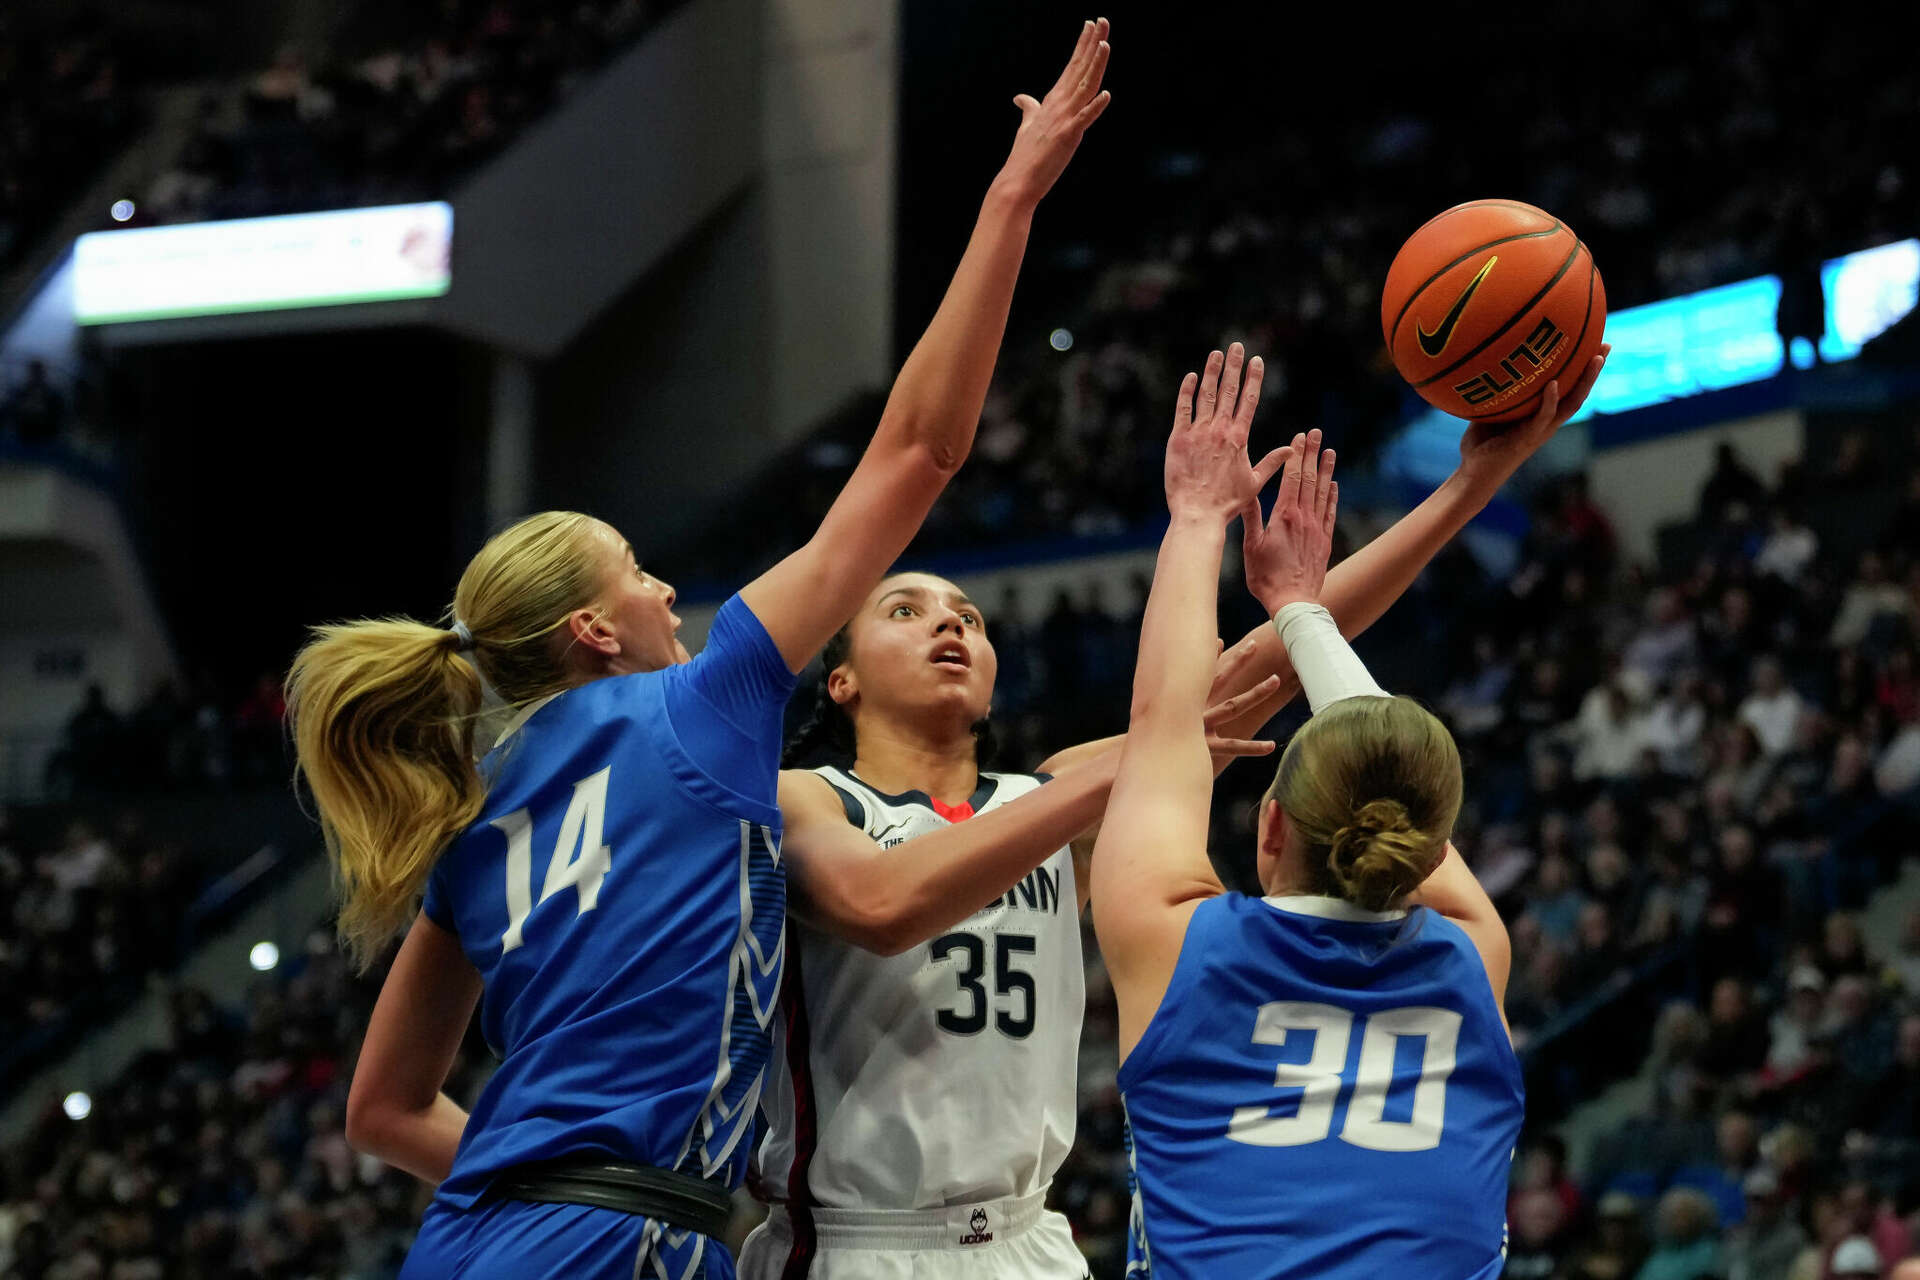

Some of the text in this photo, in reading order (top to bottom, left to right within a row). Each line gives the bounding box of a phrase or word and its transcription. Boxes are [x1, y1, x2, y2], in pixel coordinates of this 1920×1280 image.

[1453, 316, 1564, 405] ELITE
[488, 764, 612, 955] 14
[883, 837, 905, 850] THE
[984, 866, 1060, 916] NN
[928, 931, 1036, 1040] 35
[1224, 1001, 1464, 1152] 30
[959, 1232, 993, 1246] UCONN
